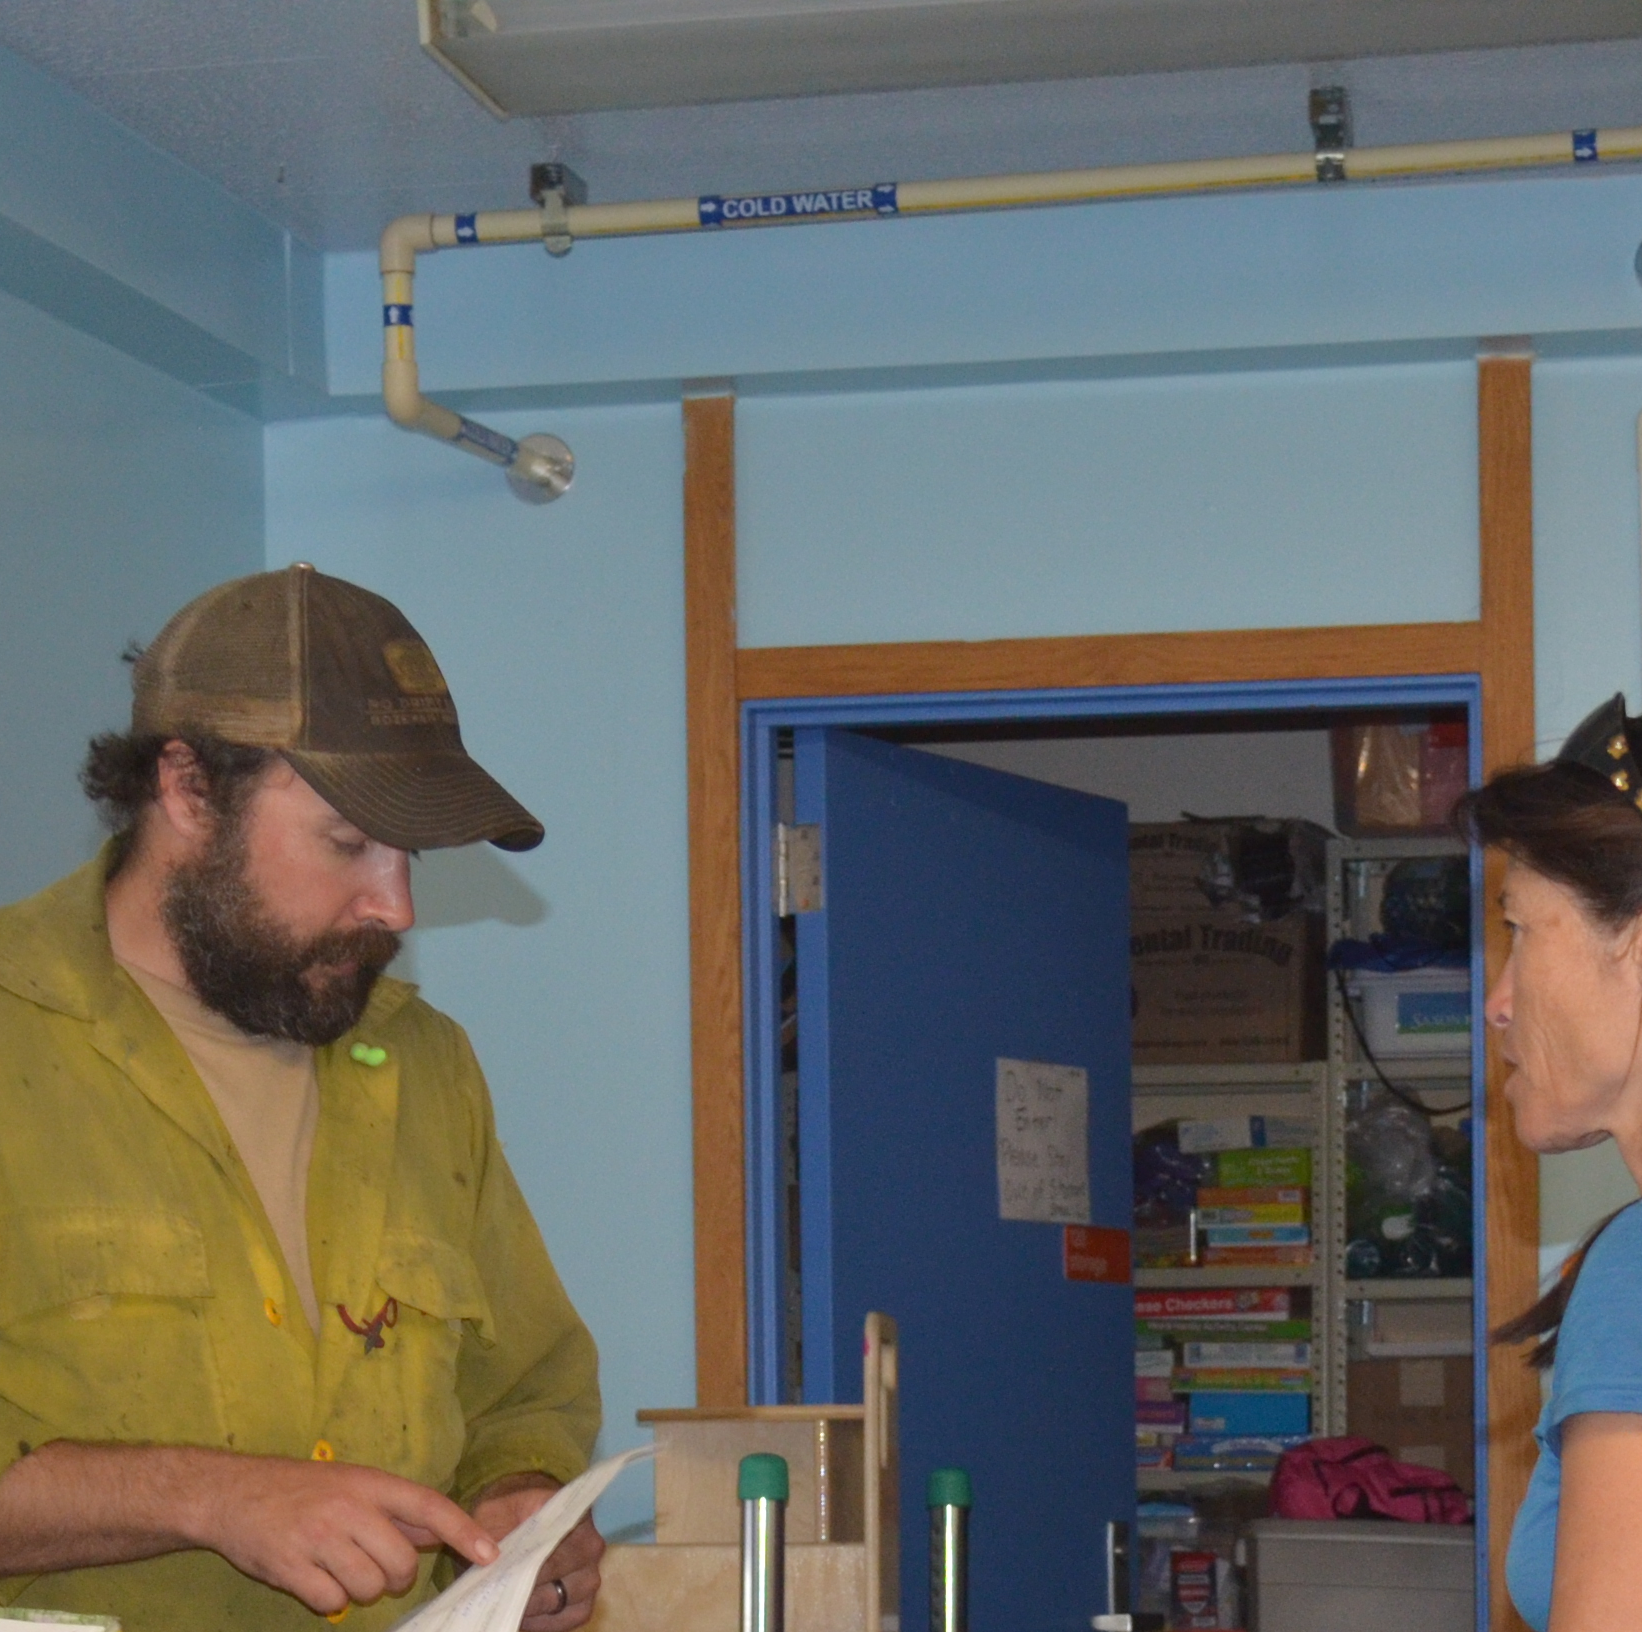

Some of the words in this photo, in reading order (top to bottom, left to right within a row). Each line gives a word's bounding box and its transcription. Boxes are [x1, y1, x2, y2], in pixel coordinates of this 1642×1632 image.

[722, 196, 787, 219] COLD
[791, 189, 874, 214] WATER
[1164, 1297, 1234, 1313] Checkers
